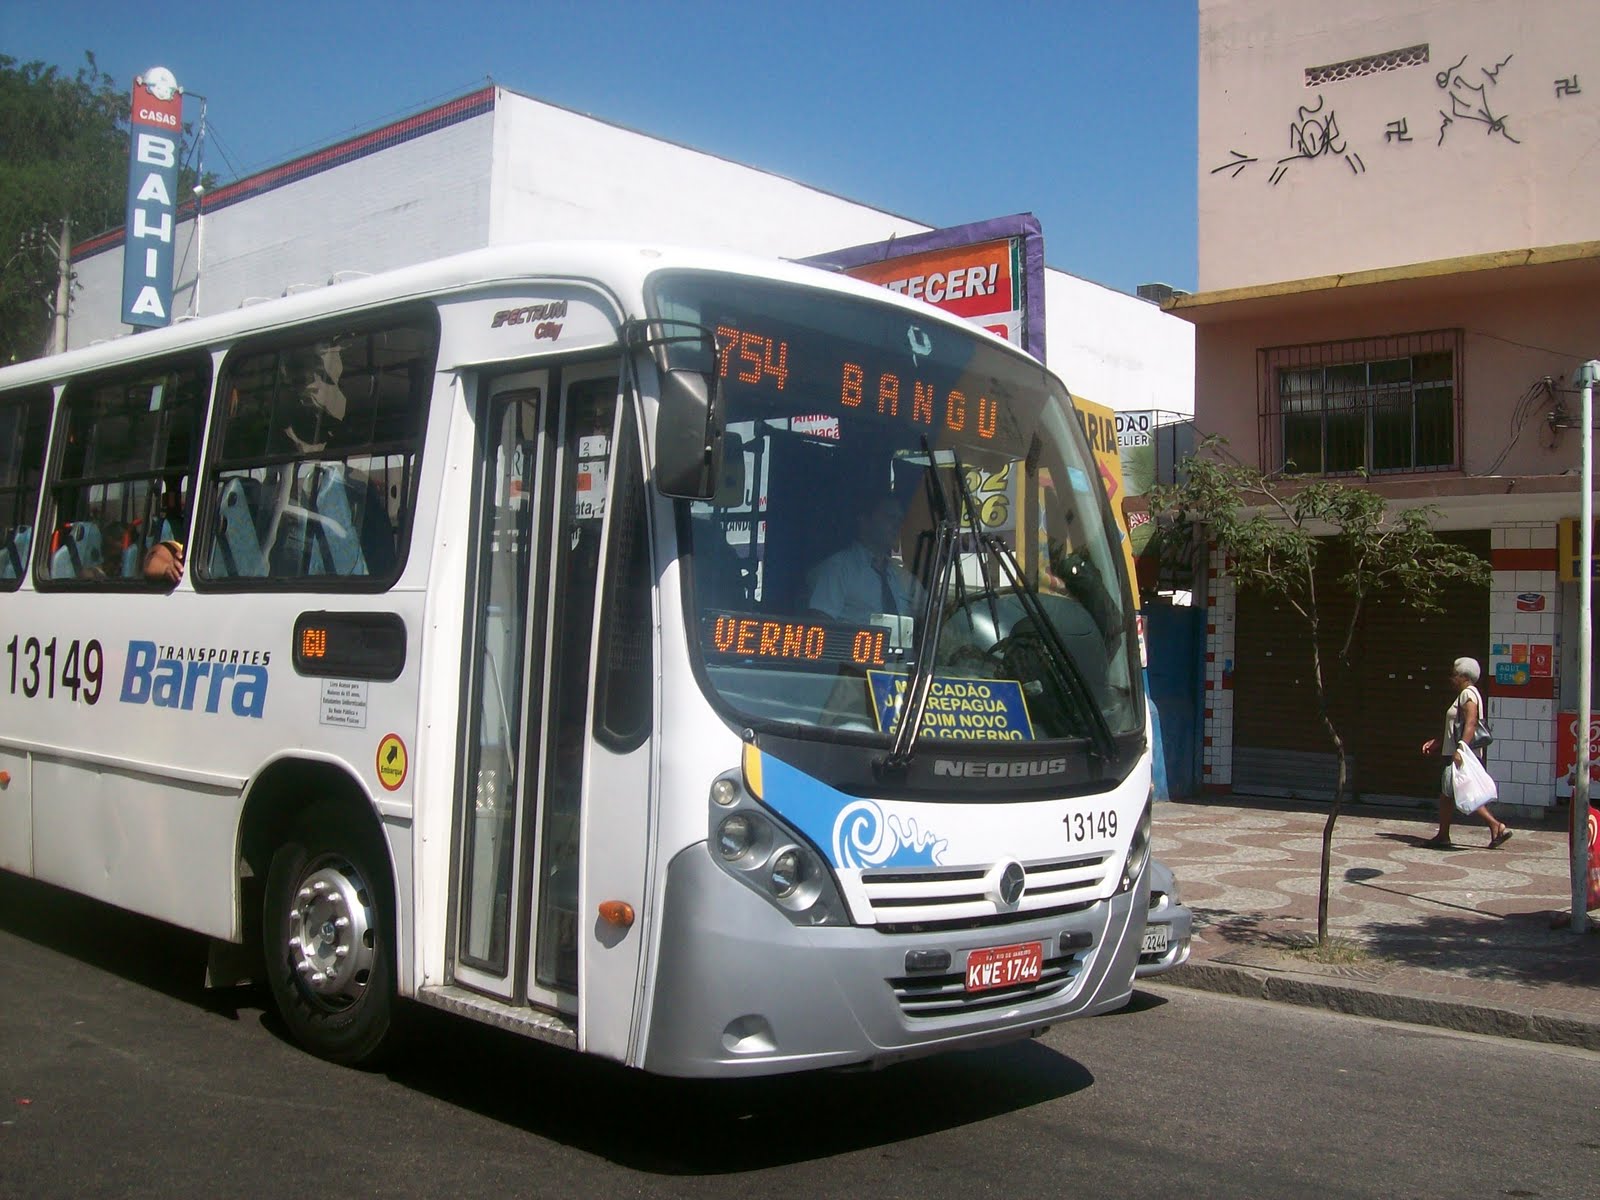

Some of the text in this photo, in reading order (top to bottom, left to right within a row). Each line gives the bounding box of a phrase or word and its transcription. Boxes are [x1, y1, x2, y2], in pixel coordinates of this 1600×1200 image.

[139, 108, 177, 126] CASAS
[131, 133, 175, 318] BAHIA
[882, 263, 998, 303] TECER!
[491, 300, 568, 328] SPECTRUM
[716, 325, 998, 440] 754 BANGU
[6, 634, 103, 705] 13149
[159, 645, 272, 666] TRANSPORTES
[119, 640, 269, 719] Barra
[895, 680, 991, 698] MCADÃO
[885, 694, 1008, 712] JREPAGUA
[892, 712, 1008, 728] JDIM NOVO
[933, 758, 1067, 778] NEOBUS
[1062, 809, 1118, 842] 13149
